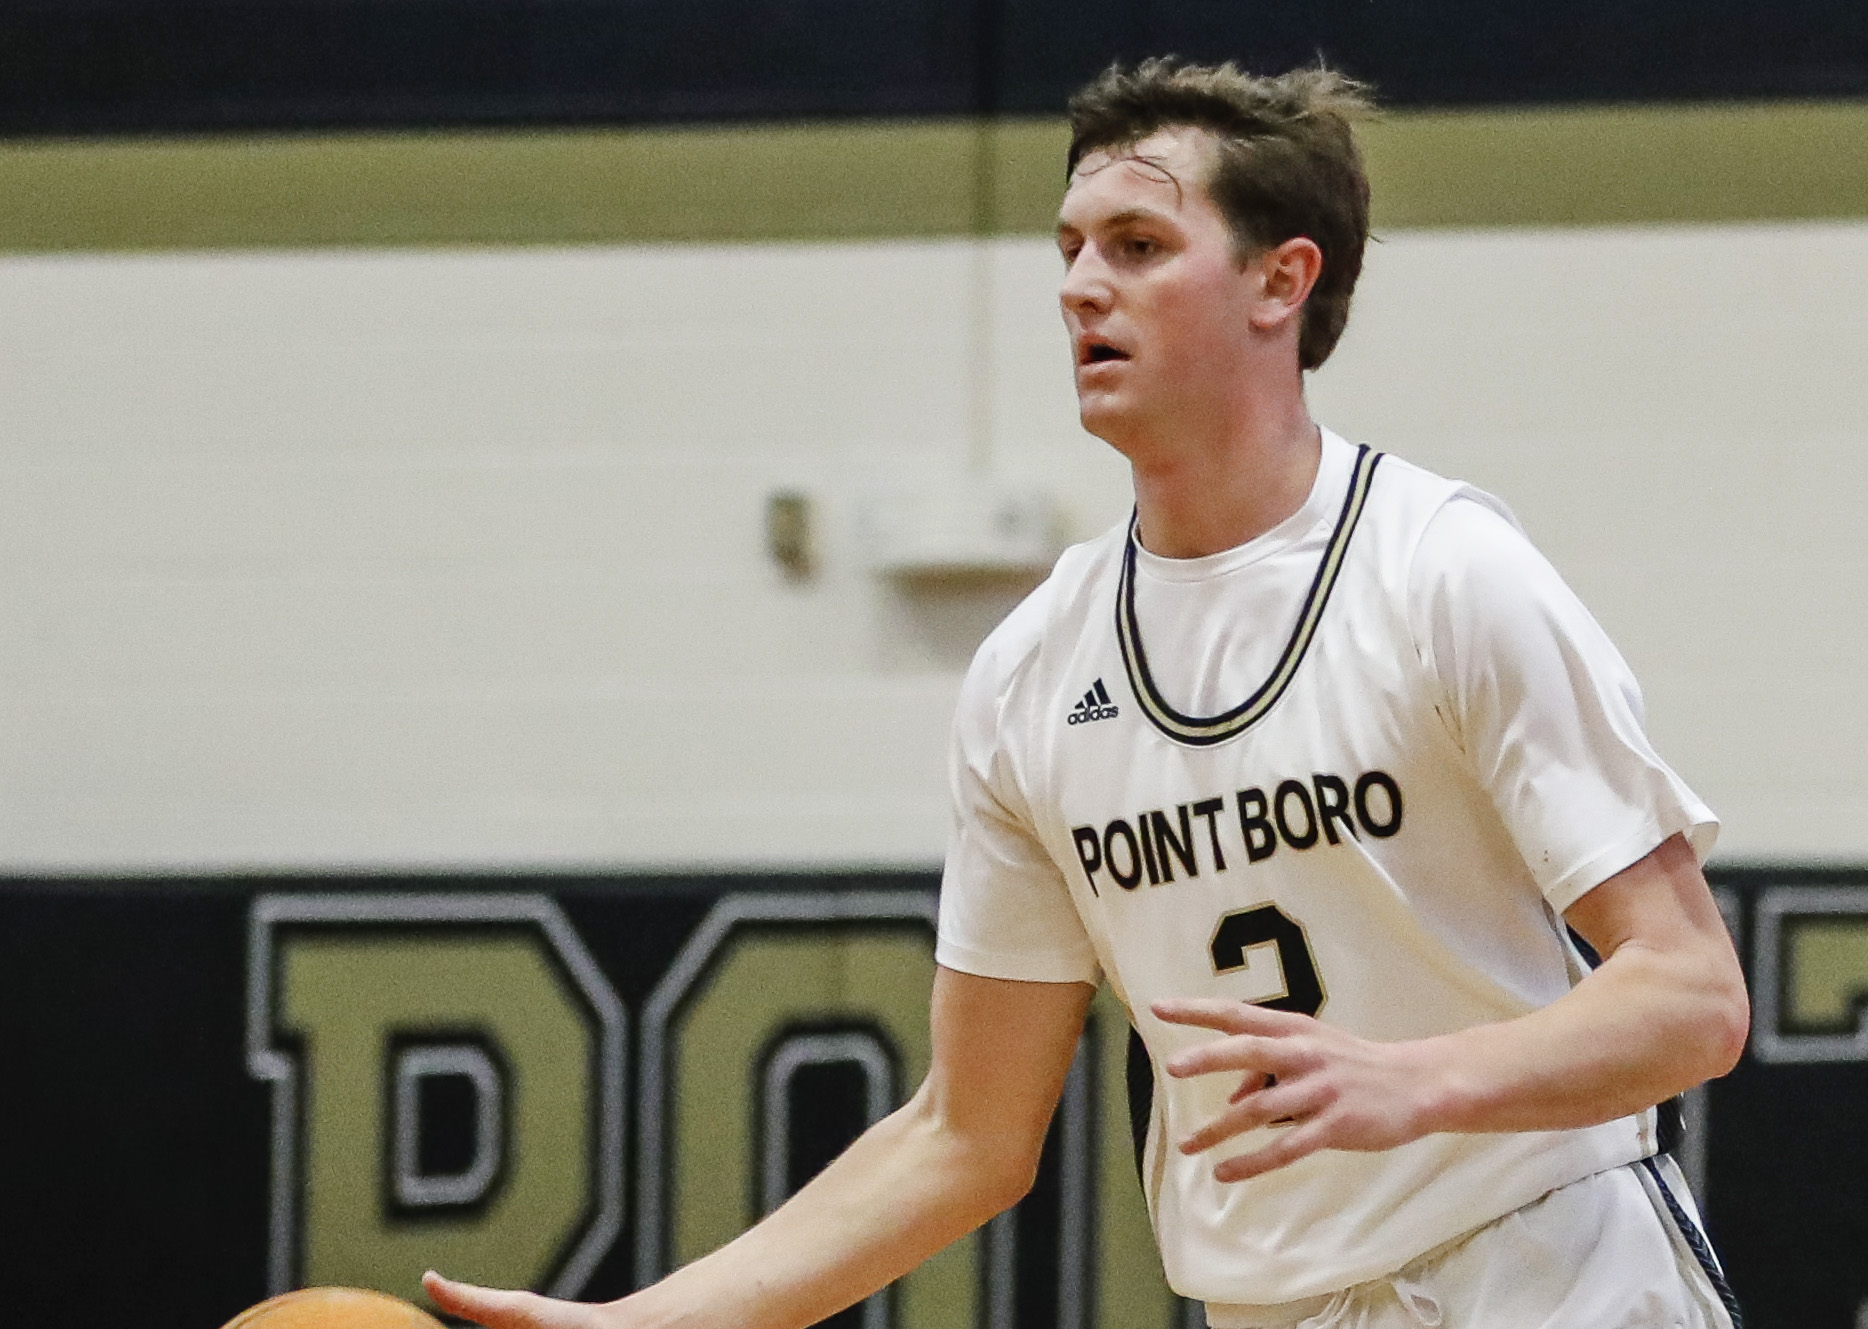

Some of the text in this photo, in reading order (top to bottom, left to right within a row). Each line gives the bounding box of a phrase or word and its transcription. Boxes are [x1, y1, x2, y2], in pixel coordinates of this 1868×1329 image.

[1067, 705, 1119, 725] adidas
[1073, 770, 1403, 897] POINT BORO
